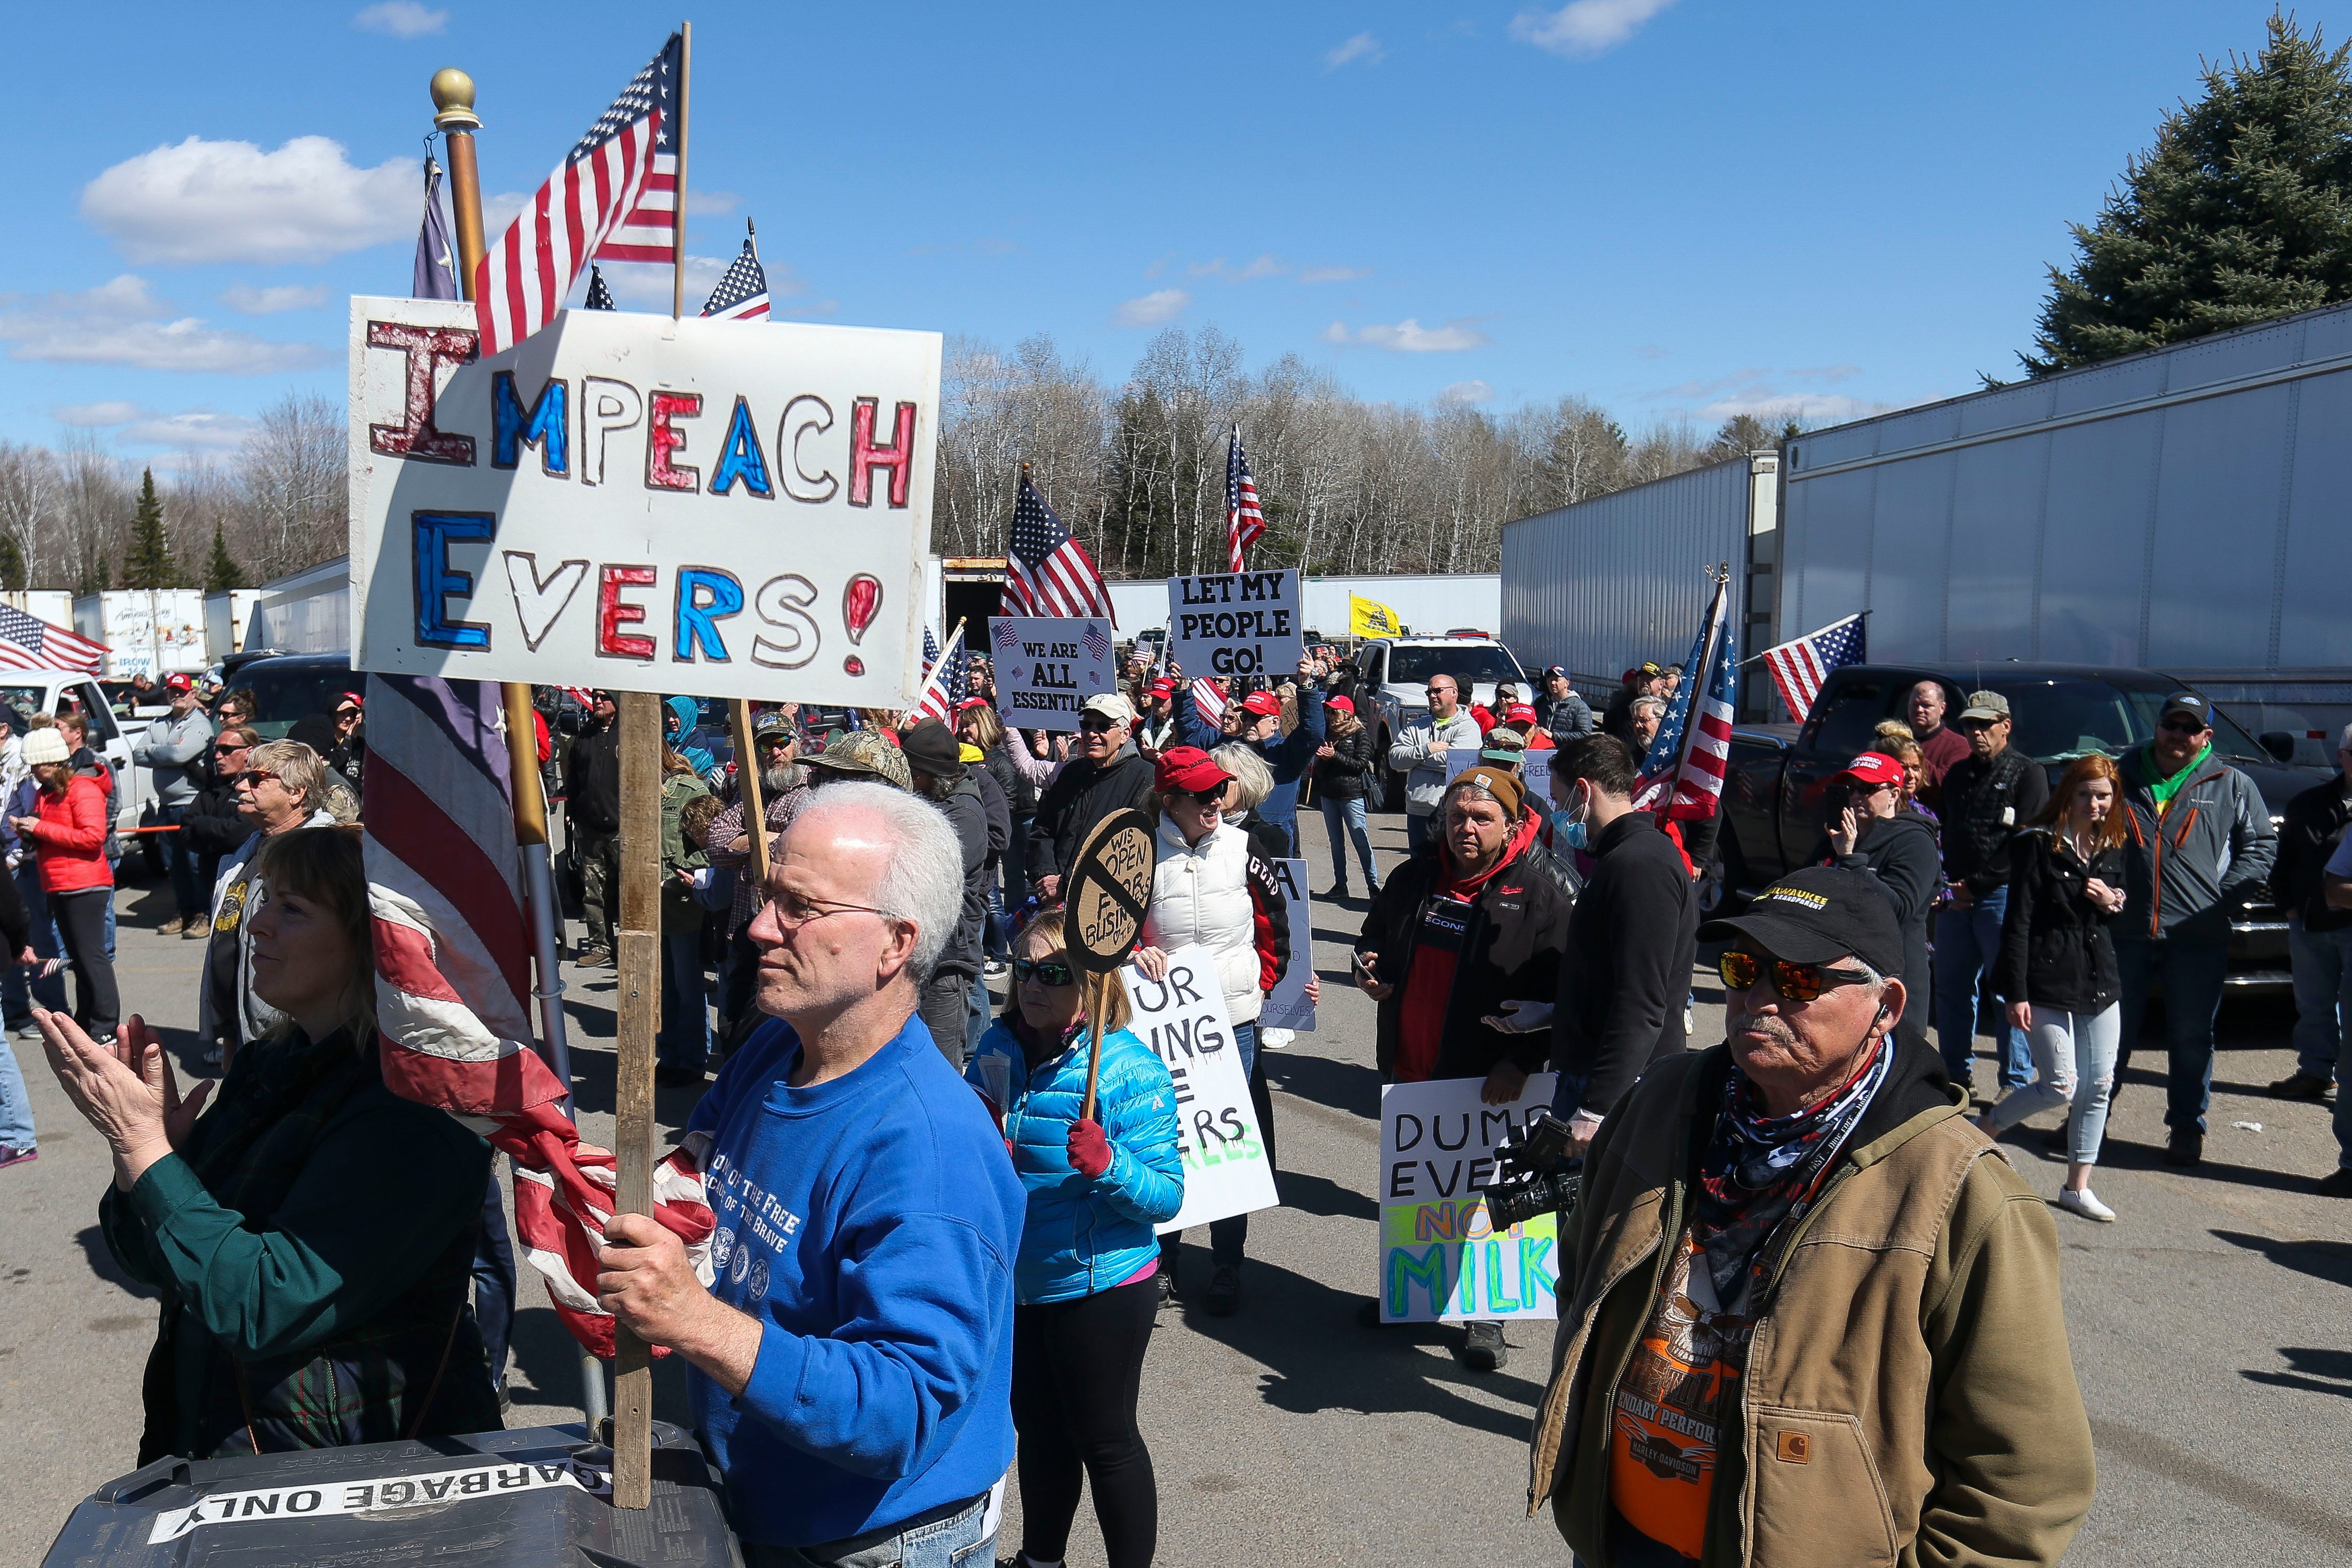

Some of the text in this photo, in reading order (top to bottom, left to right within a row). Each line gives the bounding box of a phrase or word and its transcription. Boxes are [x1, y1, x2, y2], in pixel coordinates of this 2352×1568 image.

[367, 320, 917, 509] IMPEACH
[412, 509, 883, 676] EVERS!
[1181, 572, 1284, 605] LET MY
[1180, 609, 1291, 640] PEOPLE
[1022, 642, 1079, 659] WE ARE
[1211, 644, 1264, 675] GO!
[1031, 662, 1078, 690] ALL
[1012, 691, 1094, 712] ESSENTIA
[1106, 840, 1147, 876] OPEN
[1111, 828, 1134, 852] WIS
[1389, 1157, 1495, 1197] EVE
[724, 1195, 738, 1211] OF
[739, 1204, 755, 1227] THE
[751, 1214, 789, 1254] BRAVE
[742, 1178, 764, 1208] THE
[761, 1191, 802, 1236] FREE
[1387, 1236, 1556, 1318] MILK
[1659, 1408, 1717, 1445] PERFOR
[1633, 1441, 1697, 1475] HARLEY-DAVIDSON
[172, 1462, 608, 1535] GARBAGE ONLY
